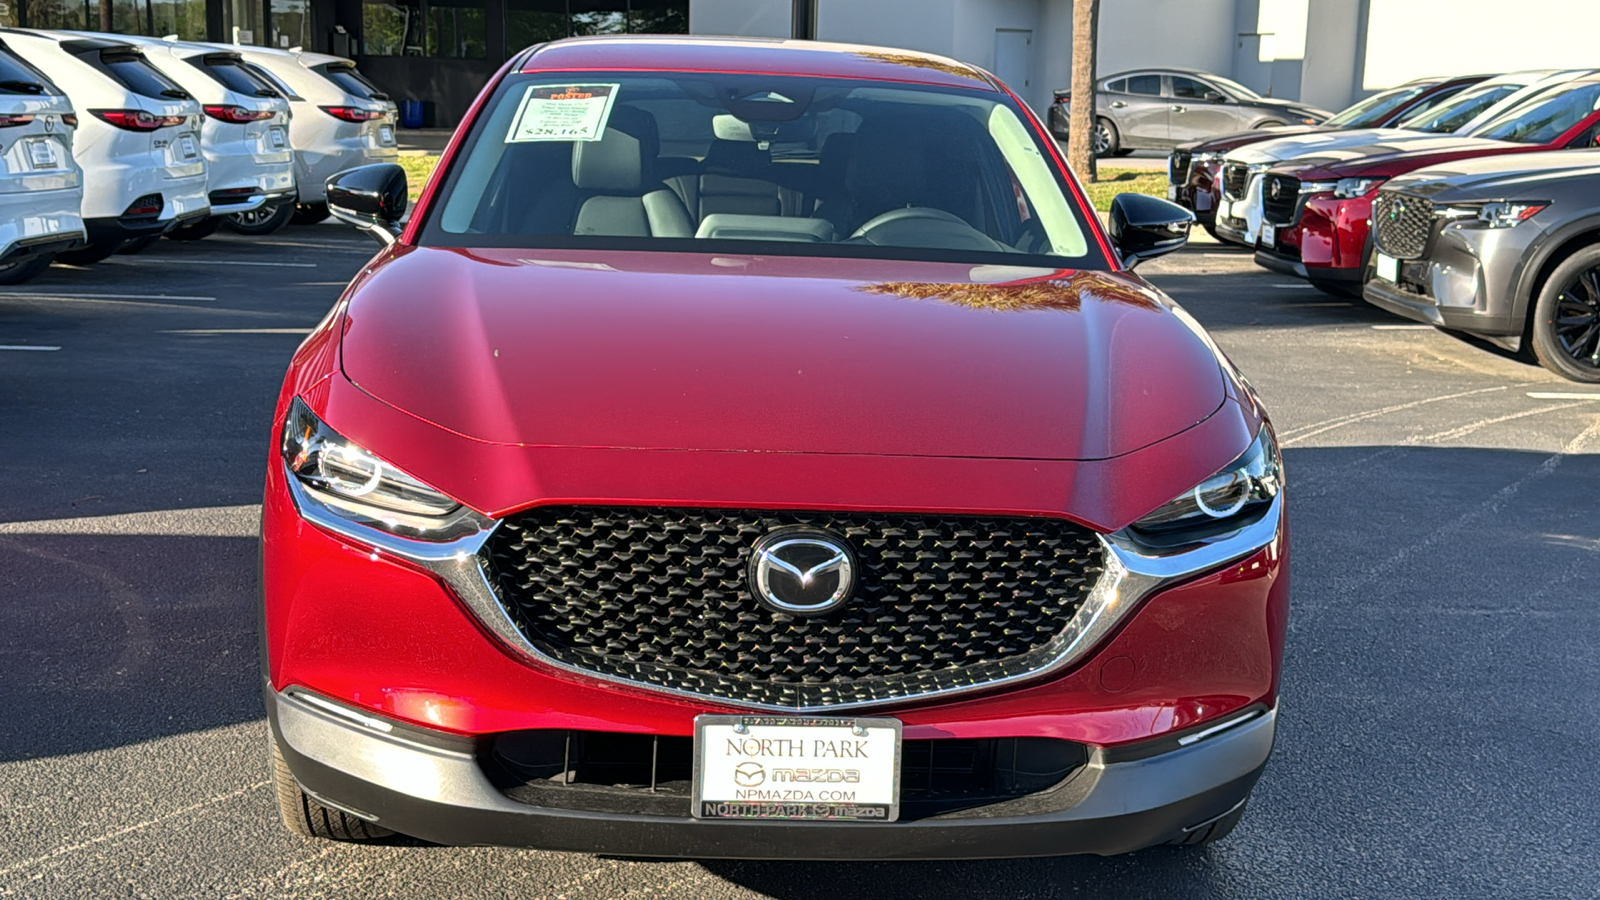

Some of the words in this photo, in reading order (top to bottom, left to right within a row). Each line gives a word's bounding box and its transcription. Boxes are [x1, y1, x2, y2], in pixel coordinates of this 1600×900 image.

[550, 92, 592, 100] POSTED
[726, 738, 804, 757] NORTH
[813, 739, 869, 758] PARK
[772, 768, 860, 783] mazda
[736, 789, 856, 801] NPMAZDA.COM
[705, 803, 761, 817] NORTH
[766, 804, 808, 817] PARK
[834, 805, 885, 818] mazda
